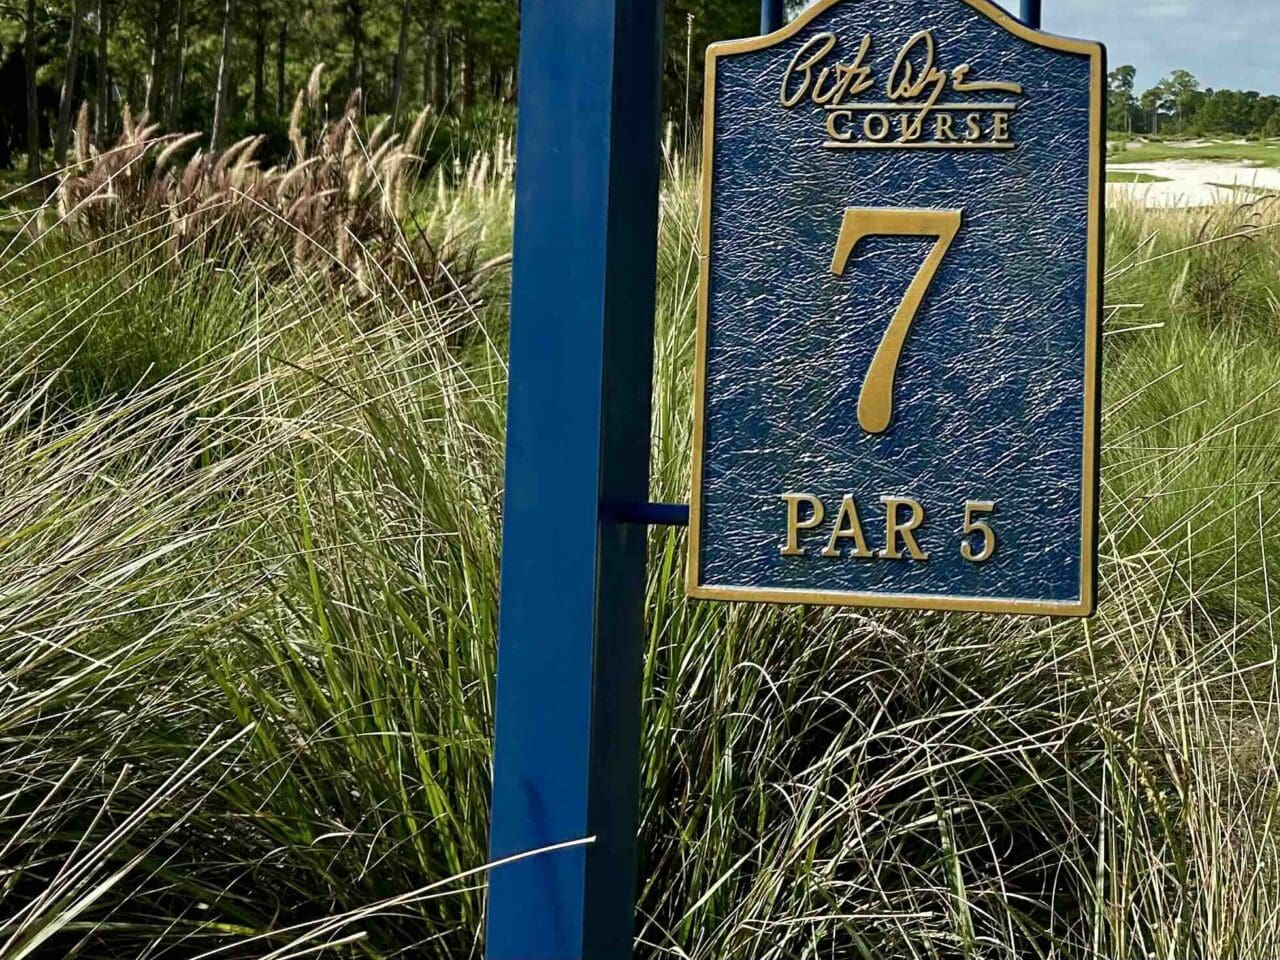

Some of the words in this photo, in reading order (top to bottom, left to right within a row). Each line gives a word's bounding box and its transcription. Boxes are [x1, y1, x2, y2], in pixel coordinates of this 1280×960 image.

[826, 110, 1012, 141] COURSE
[830, 207, 963, 434] 7
[780, 493, 928, 561] PAR
[960, 500, 996, 562] 5
